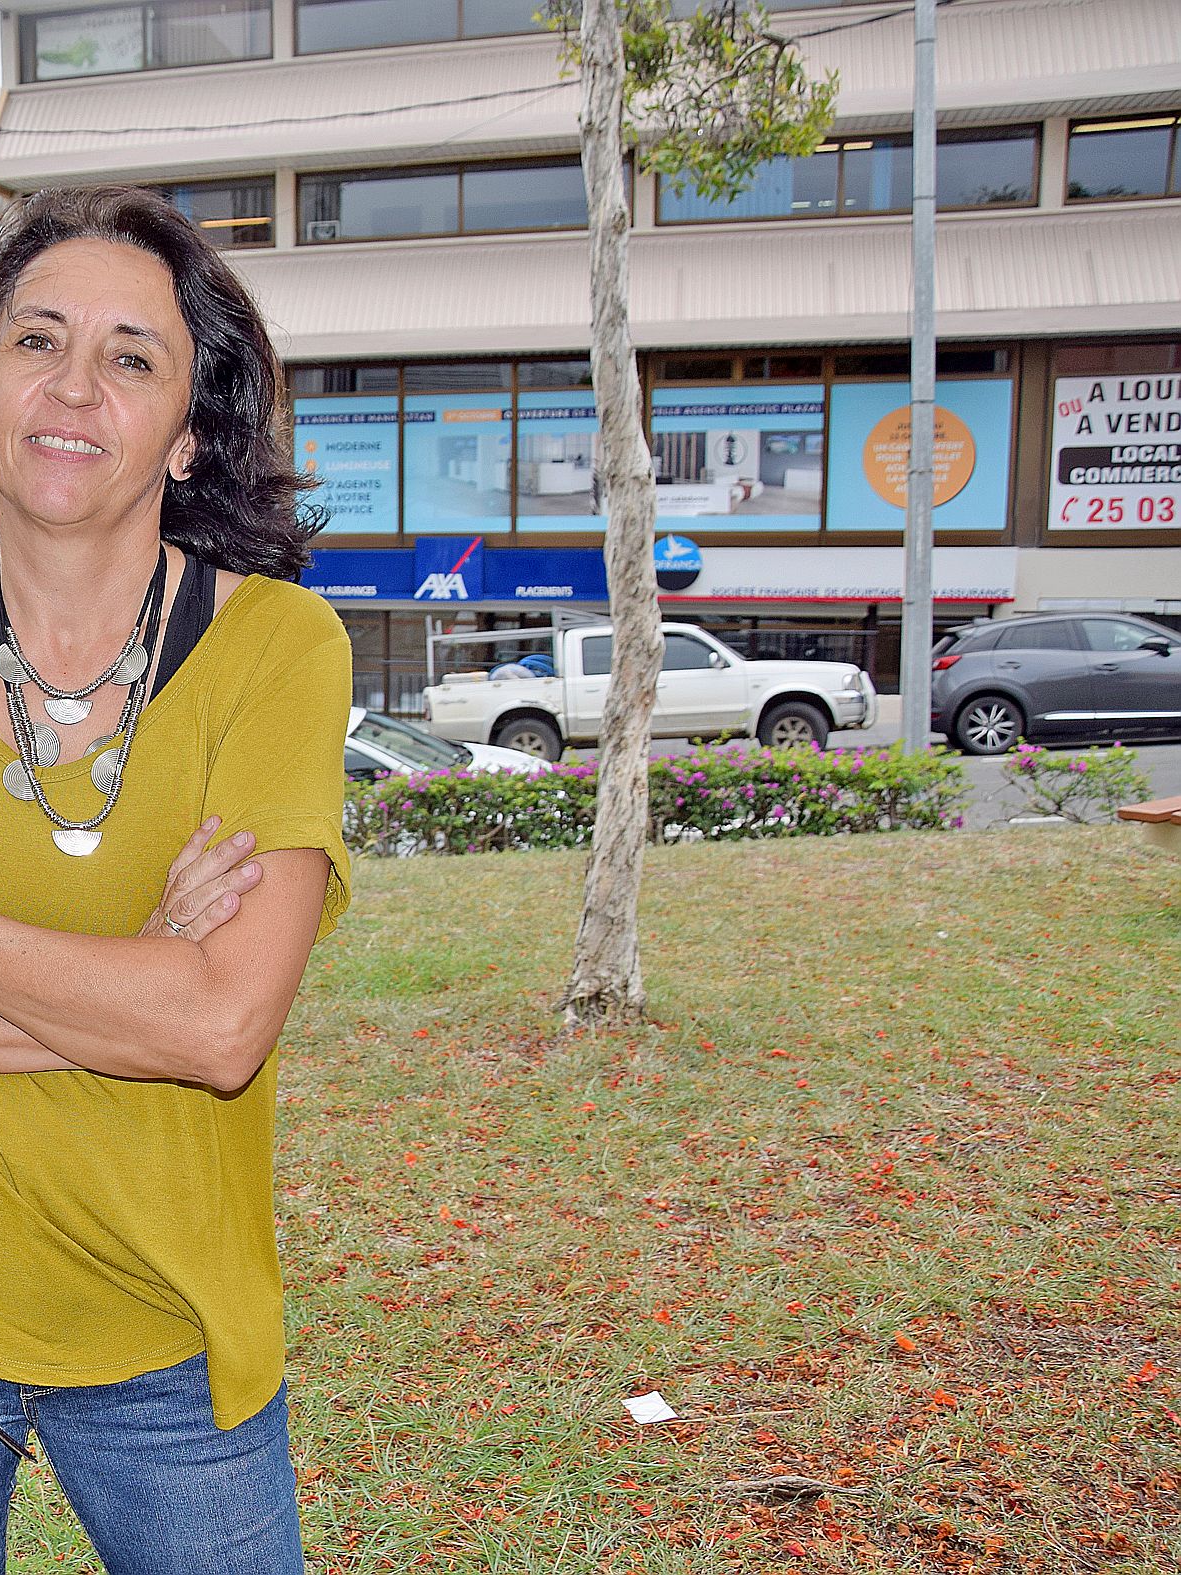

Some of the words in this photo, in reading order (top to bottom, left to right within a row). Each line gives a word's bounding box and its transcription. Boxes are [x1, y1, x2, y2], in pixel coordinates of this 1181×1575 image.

[1089, 382, 1104, 402] A
[1058, 399, 1082, 417] OU
[1076, 415, 1092, 434] A
[325, 441, 382, 451] MODERNE
[1087, 498, 1124, 523] 25
[1138, 497, 1175, 522] 03
[326, 585, 377, 597] ASSURANCES
[413, 572, 469, 600] AXA
[515, 585, 574, 598] PLACEMENTS
[939, 587, 1011, 598] ASSURANCE
